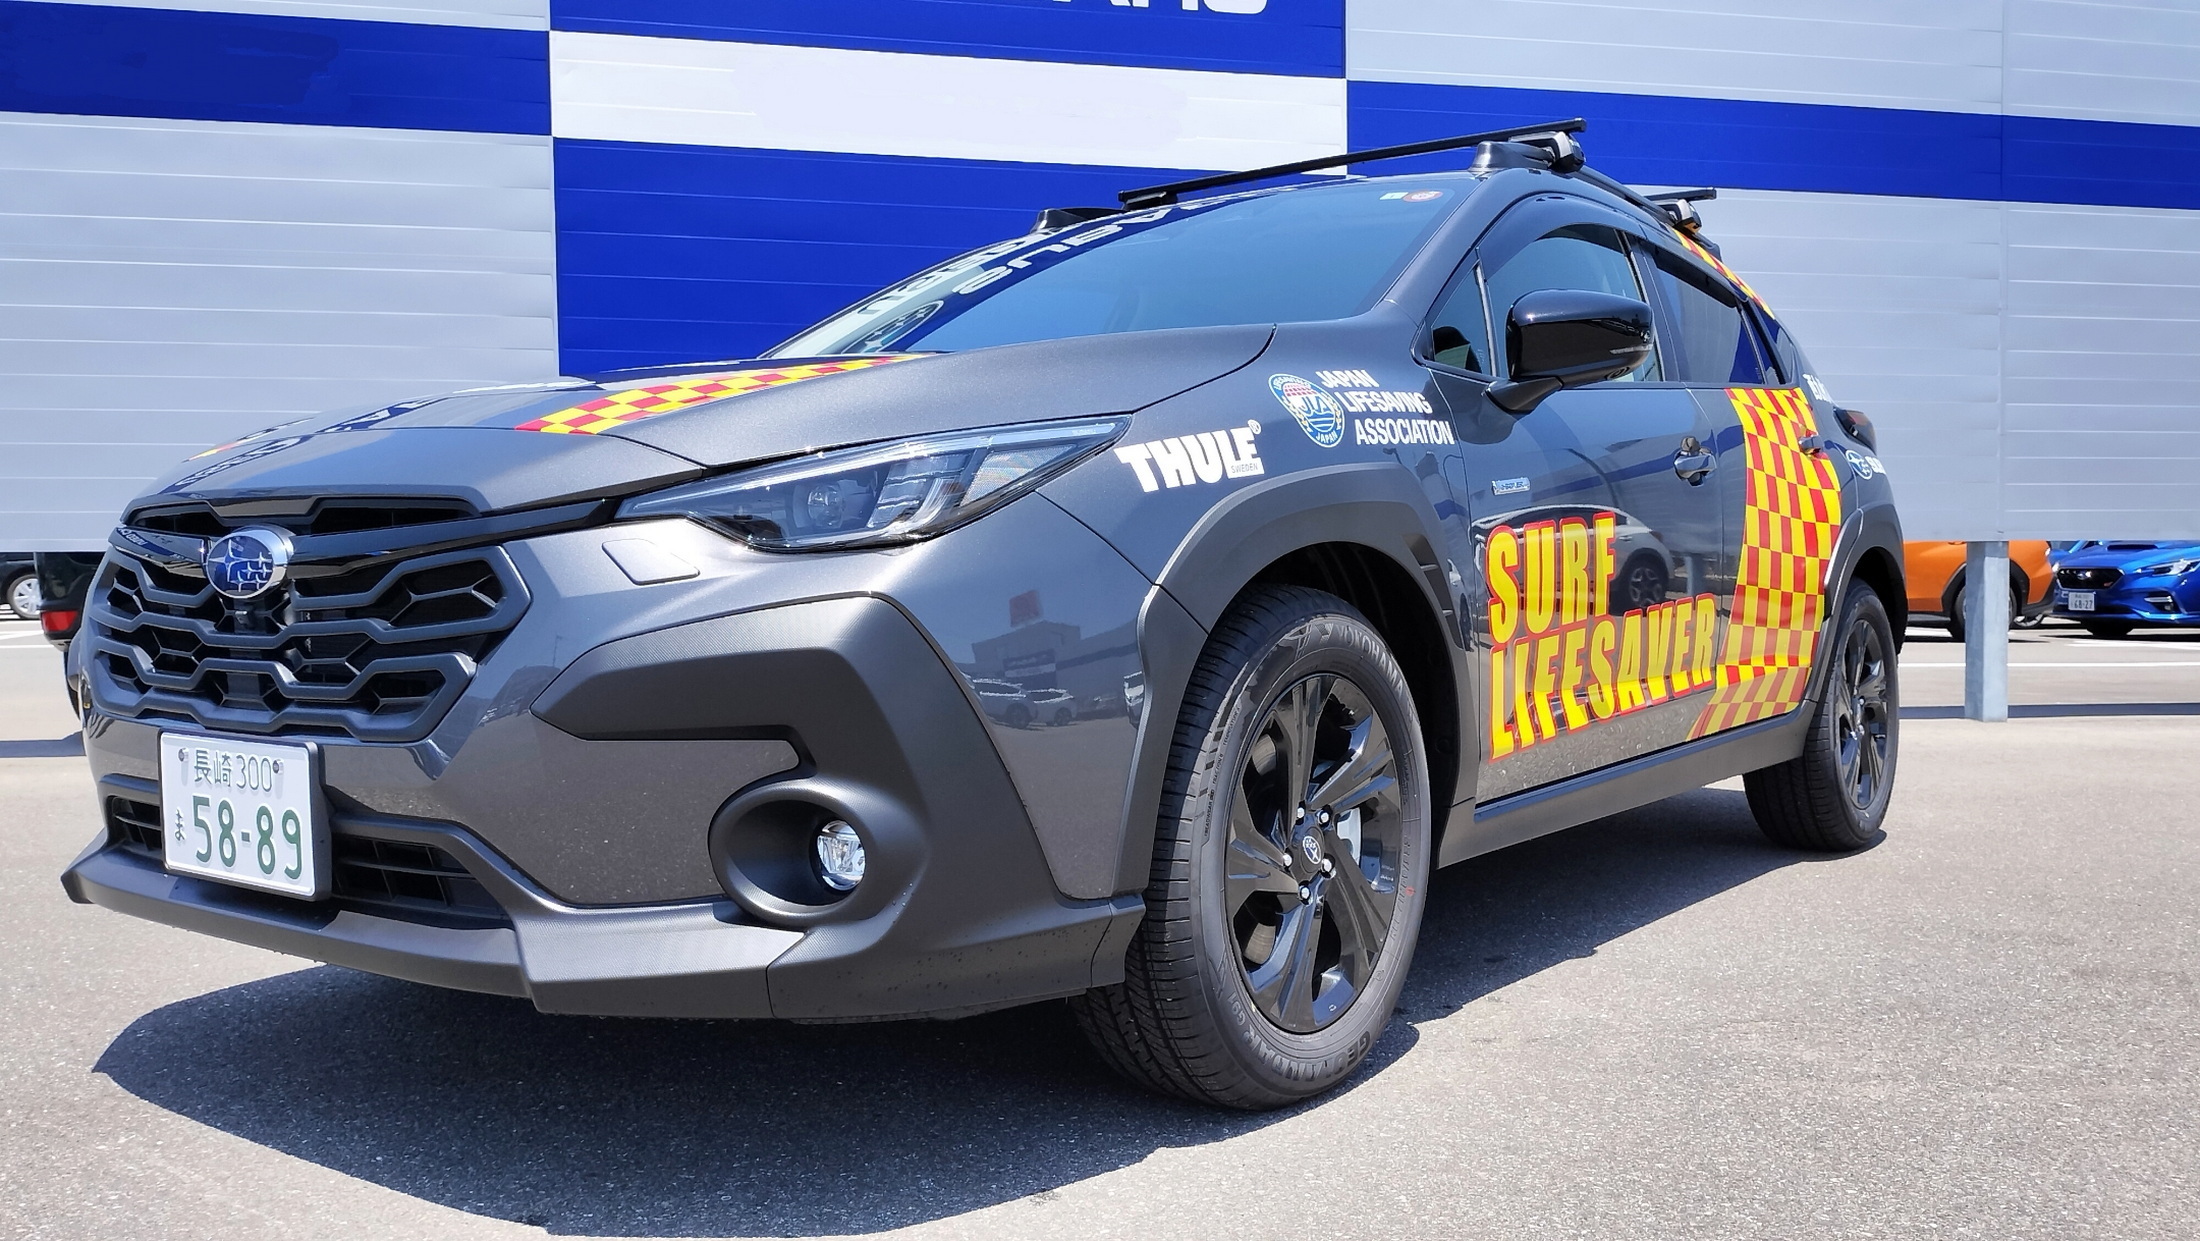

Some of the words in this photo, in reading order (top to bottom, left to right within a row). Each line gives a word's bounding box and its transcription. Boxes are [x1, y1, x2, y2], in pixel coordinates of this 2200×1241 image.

[1315, 369, 1379, 389] JAPAN
[1334, 391, 1433, 415] LIFESAVING
[1315, 430, 1338, 443] JAPAN
[1354, 418, 1455, 446] ASSOCIATION
[1114, 427, 1265, 493] THULE
[1231, 463, 1258, 473] SWEDEN
[1487, 512, 1616, 645] SURF
[1490, 595, 1715, 761] LIFESAVER
[192, 795, 303, 880] 58-89
